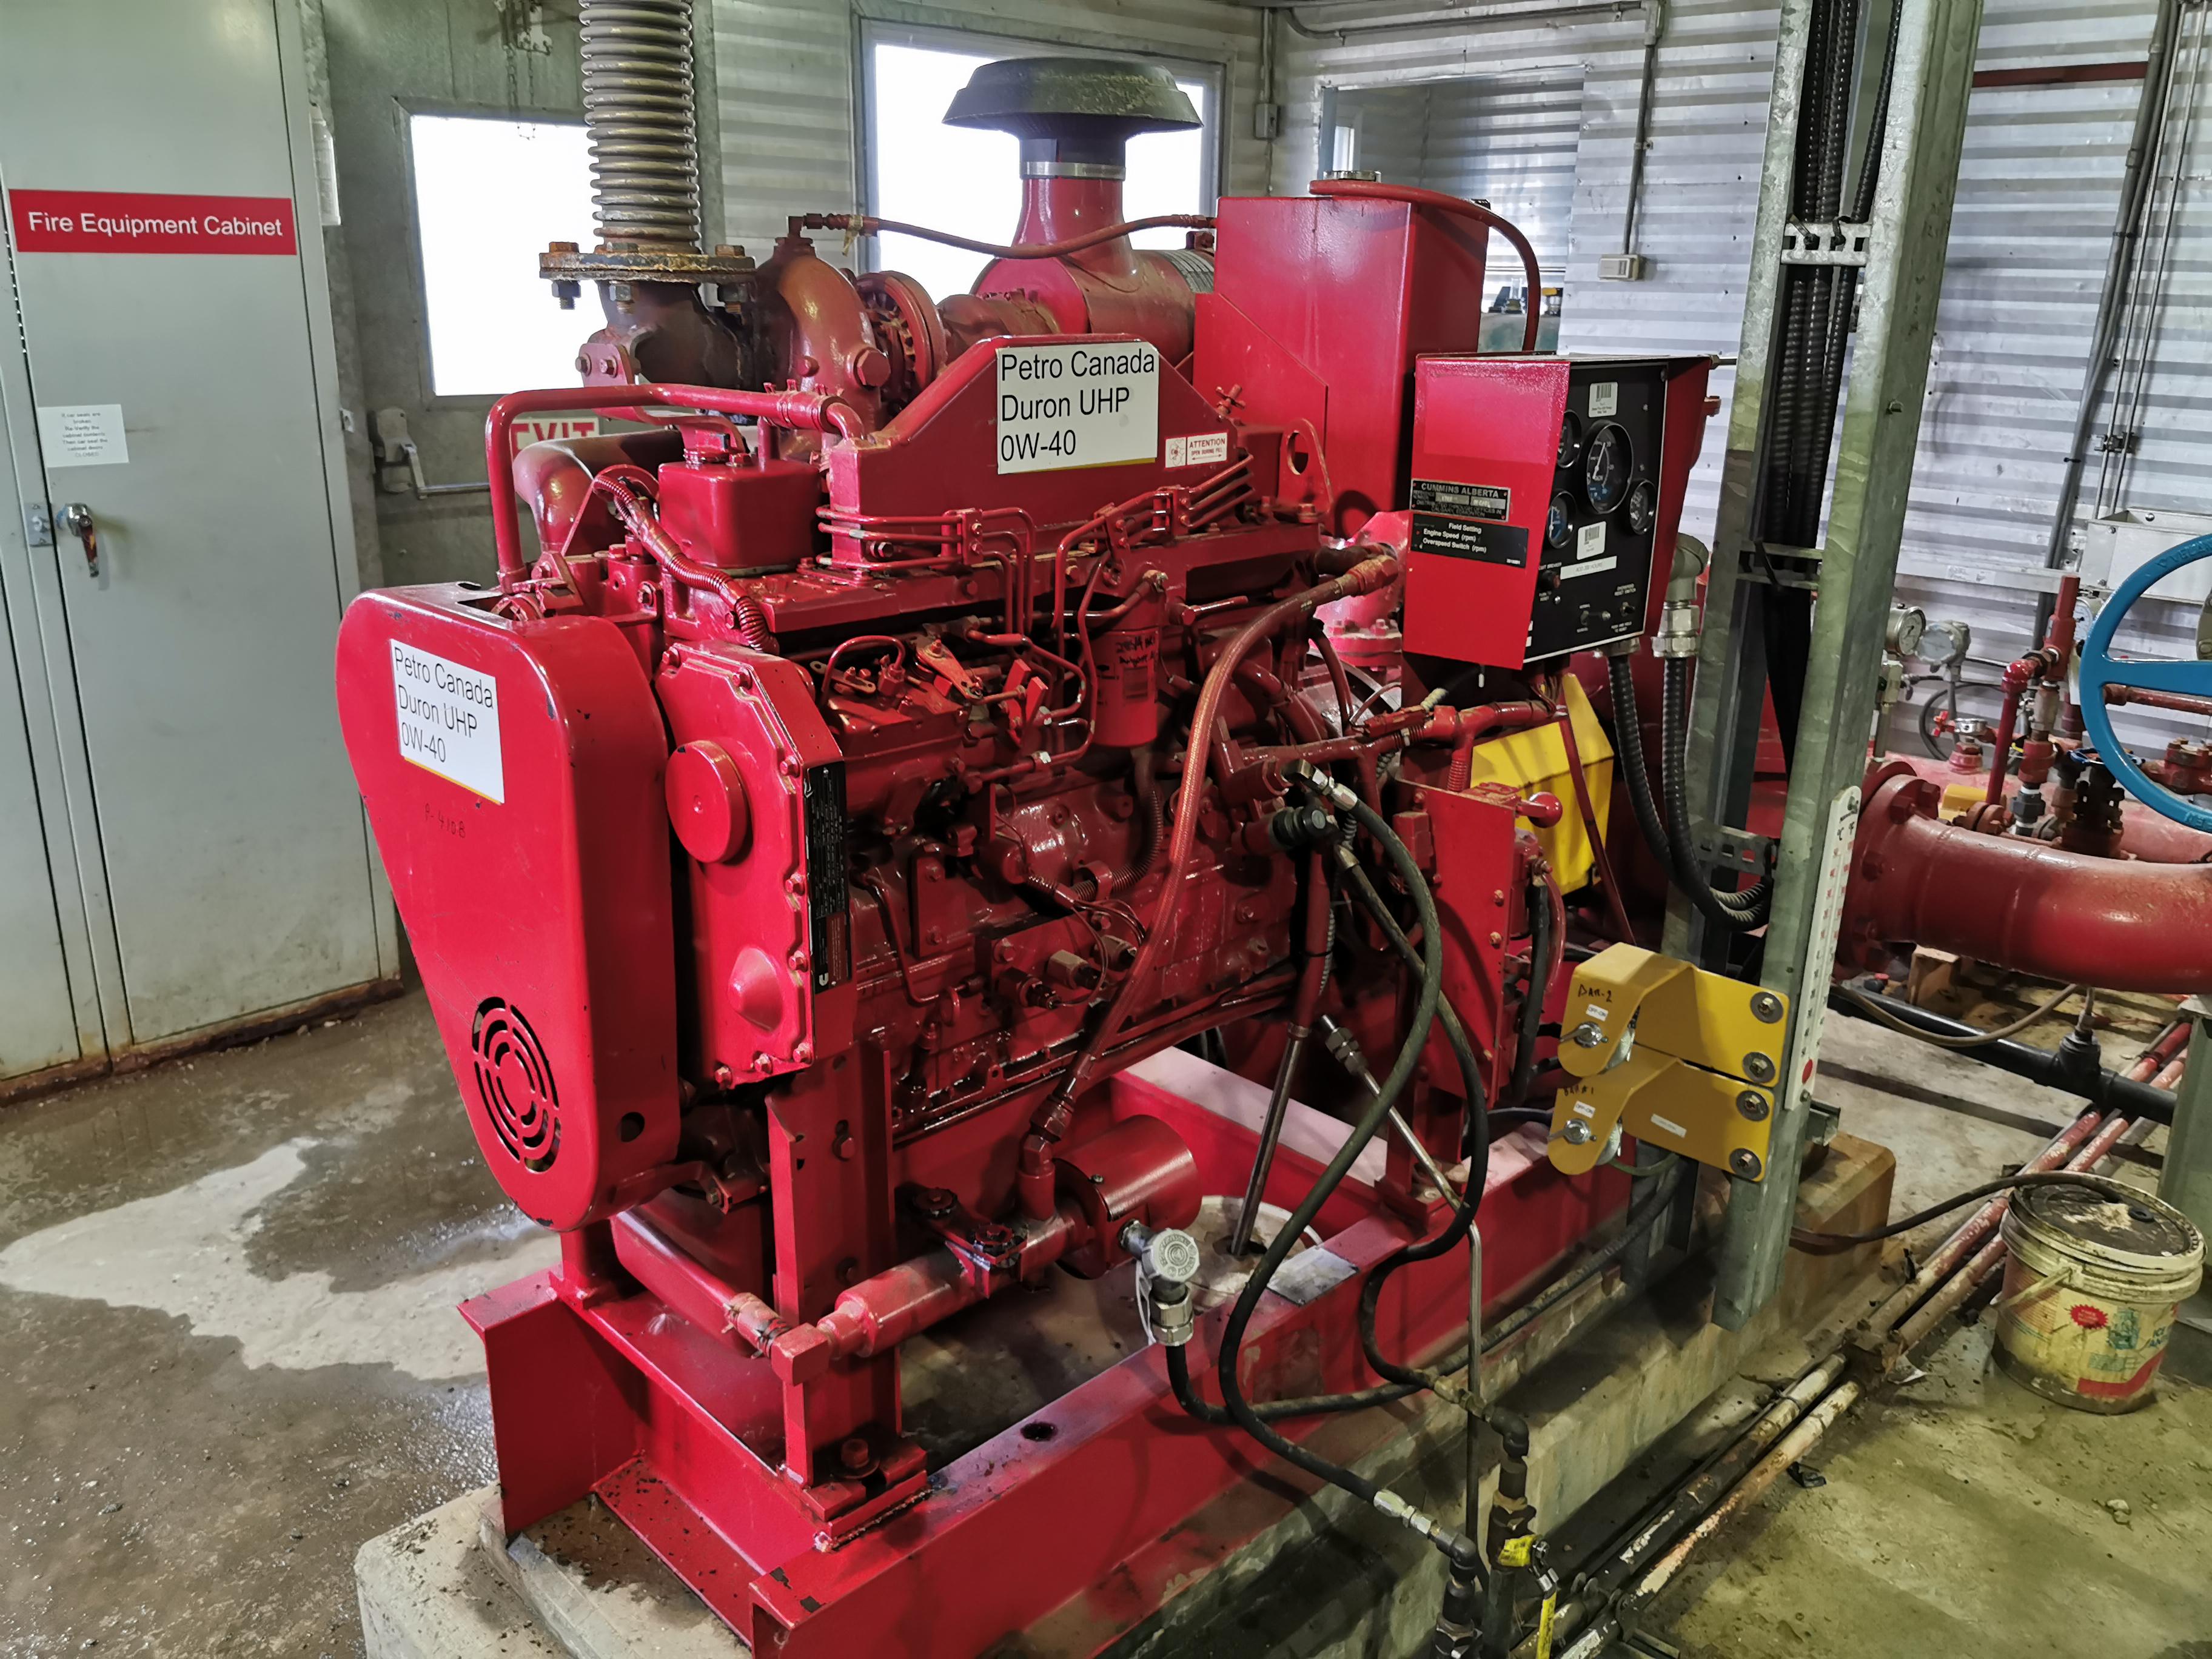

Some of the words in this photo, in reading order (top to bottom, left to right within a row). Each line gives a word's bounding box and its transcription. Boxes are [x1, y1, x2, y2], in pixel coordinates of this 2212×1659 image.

[28, 212, 73, 232] Fire
[80, 212, 199, 238] Equipment
[204, 215, 283, 236] Cabinet
[1002, 354, 1062, 381] Petro
[1071, 348, 1155, 377] Canada
[1002, 394, 1070, 421] Duron
[1080, 387, 1130, 415] UHP
[1001, 429, 1076, 461] 0W-40
[1189, 438, 1225, 448] ATTENTION
[1421, 483, 1460, 494] CUMMINS
[1461, 487, 1499, 498] ALBERTA
[1423, 529, 1442, 537] Engine
[1442, 531, 1460, 540] Speed
[1461, 534, 1476, 543] (rpm)
[1463, 525, 1482, 534] Setting
[1423, 537, 1451, 548] Overspeed
[1452, 541, 1470, 551] Switch
[1472, 545, 1487, 554] (rpm)
[394, 646, 431, 683] Petro
[435, 663, 494, 709] Canada
[398, 684, 440, 725] Duron
[443, 702, 477, 738] UHP
[401, 722, 446, 763] 0W-40
